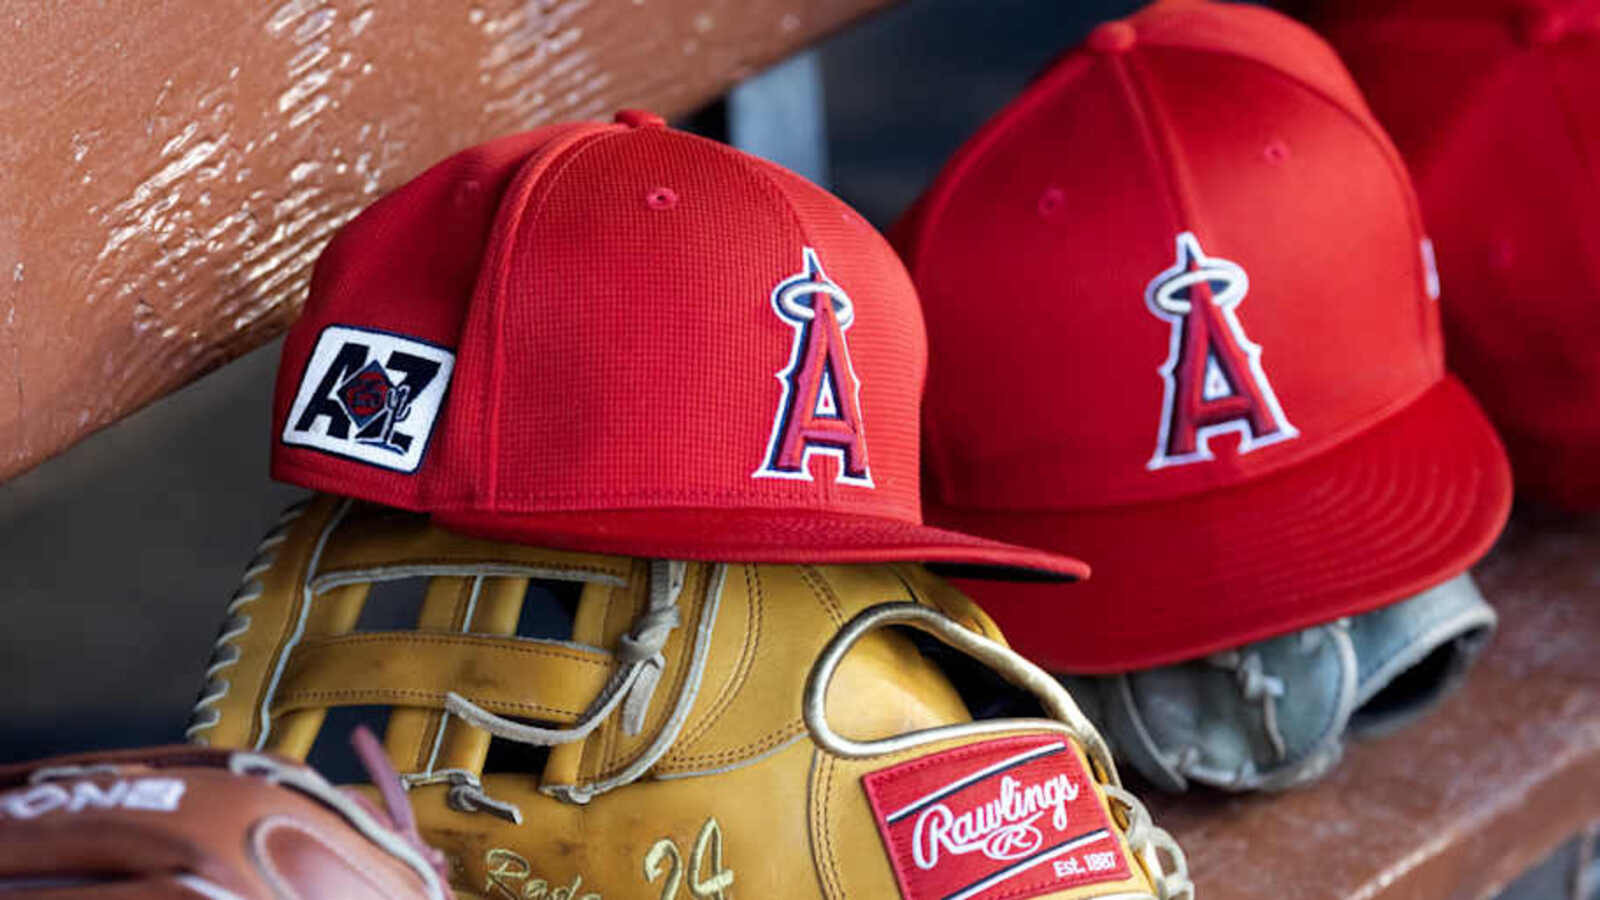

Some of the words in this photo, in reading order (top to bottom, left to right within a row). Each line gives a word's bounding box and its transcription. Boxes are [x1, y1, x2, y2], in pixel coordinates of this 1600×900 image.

[294, 342, 441, 453] AZ
[752, 247, 875, 488] A
[1145, 231, 1300, 470] A
[912, 774, 1079, 869] Rawlings
